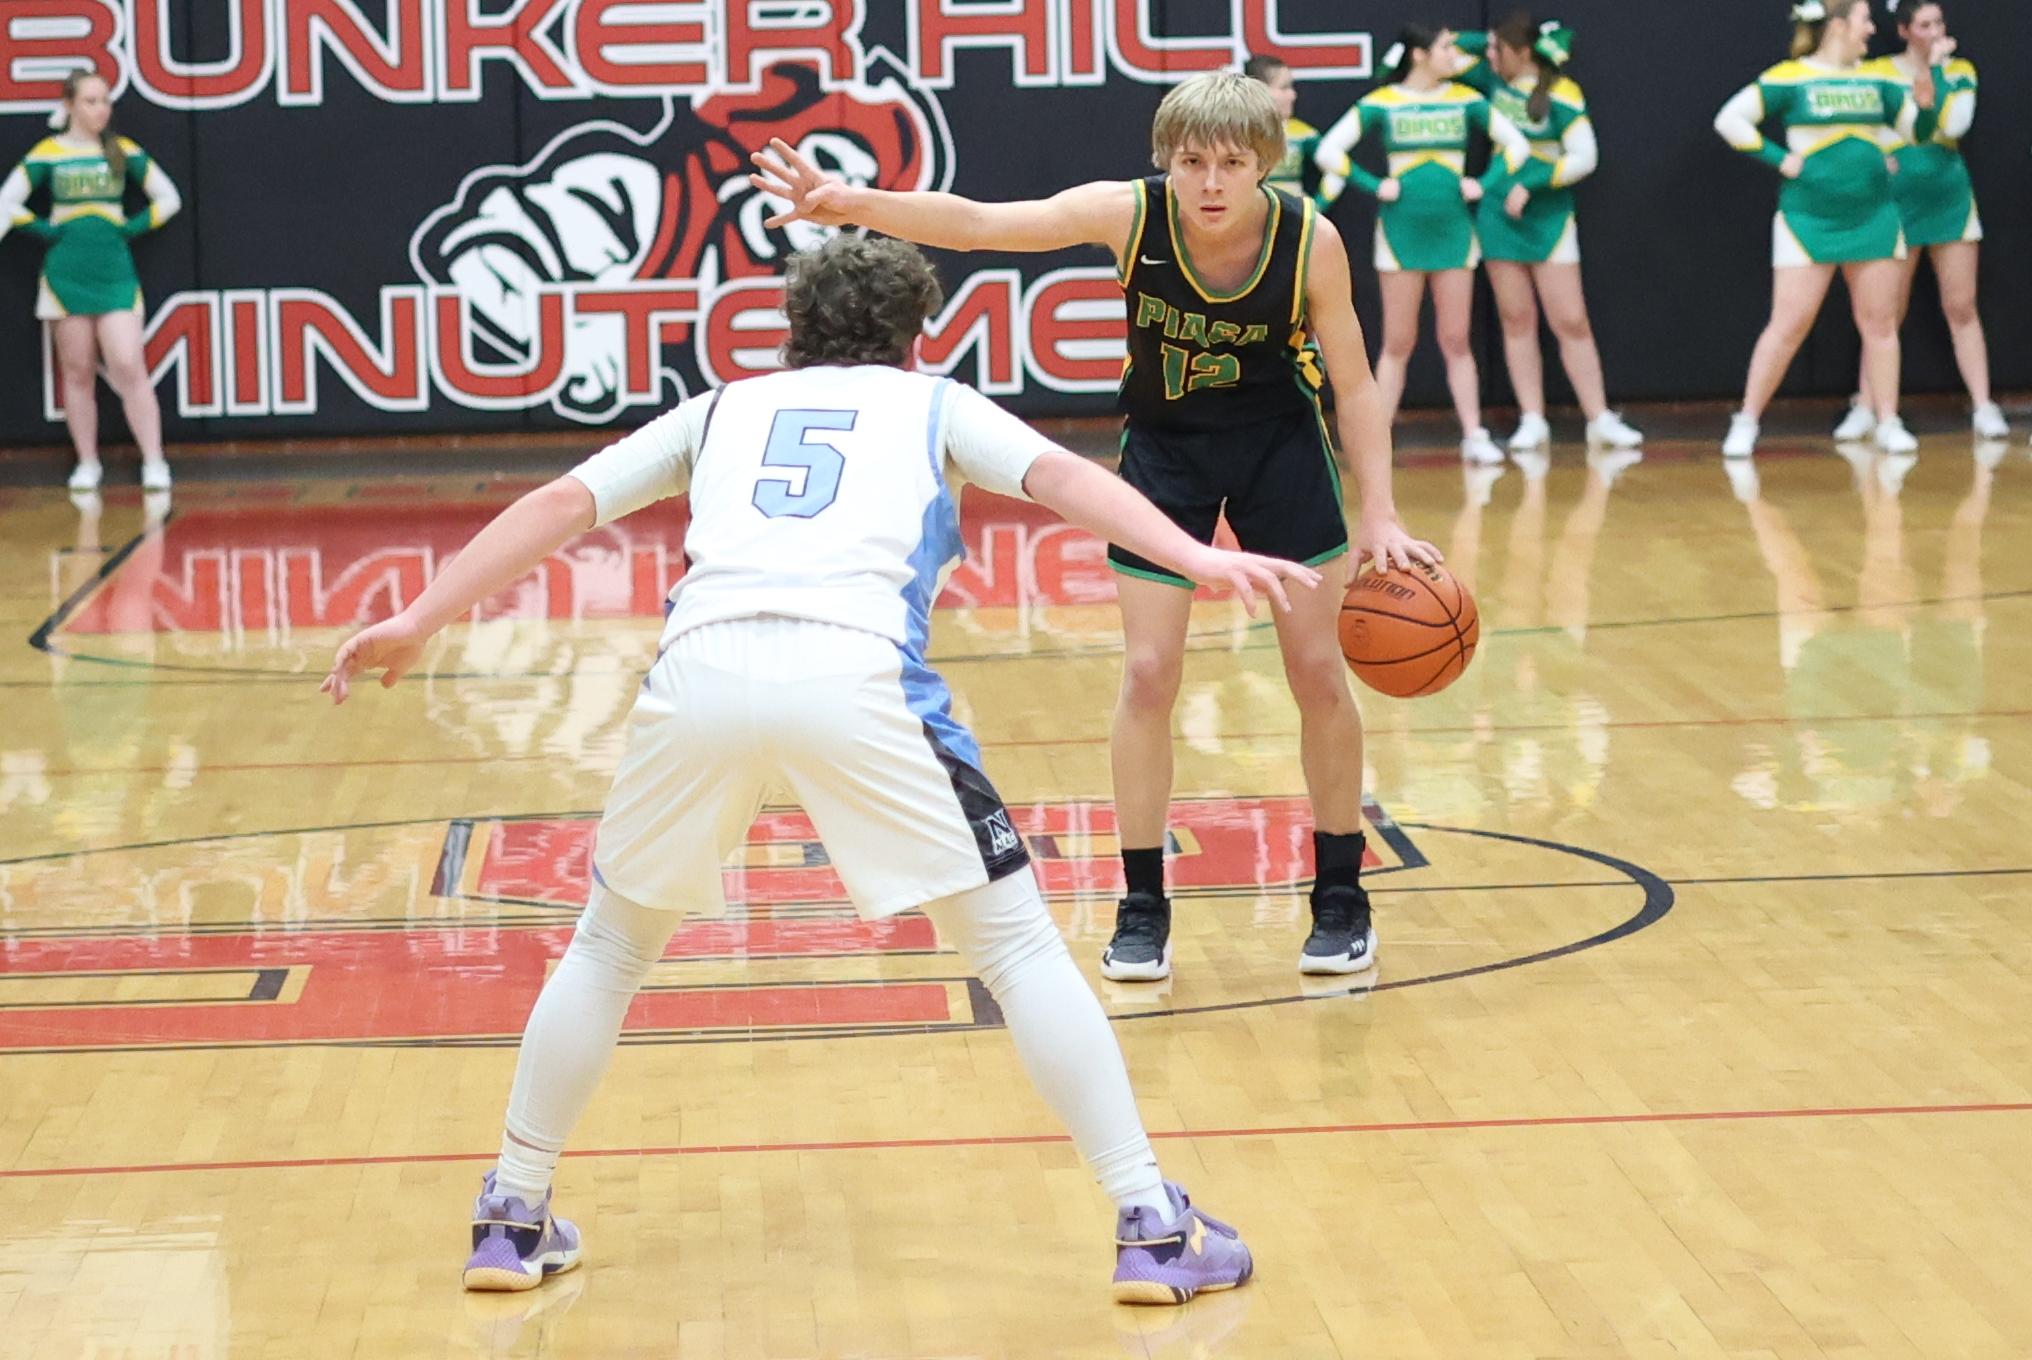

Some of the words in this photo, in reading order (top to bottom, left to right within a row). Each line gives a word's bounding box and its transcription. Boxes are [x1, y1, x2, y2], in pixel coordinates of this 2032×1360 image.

[0, 0, 865, 114] BUNKER
[907, 0, 1373, 88] HILL
[44, 267, 1128, 420] MINUTEME
[1136, 291, 1268, 348] PIASA
[1160, 342, 1241, 400] 12
[751, 408, 859, 519] 5
